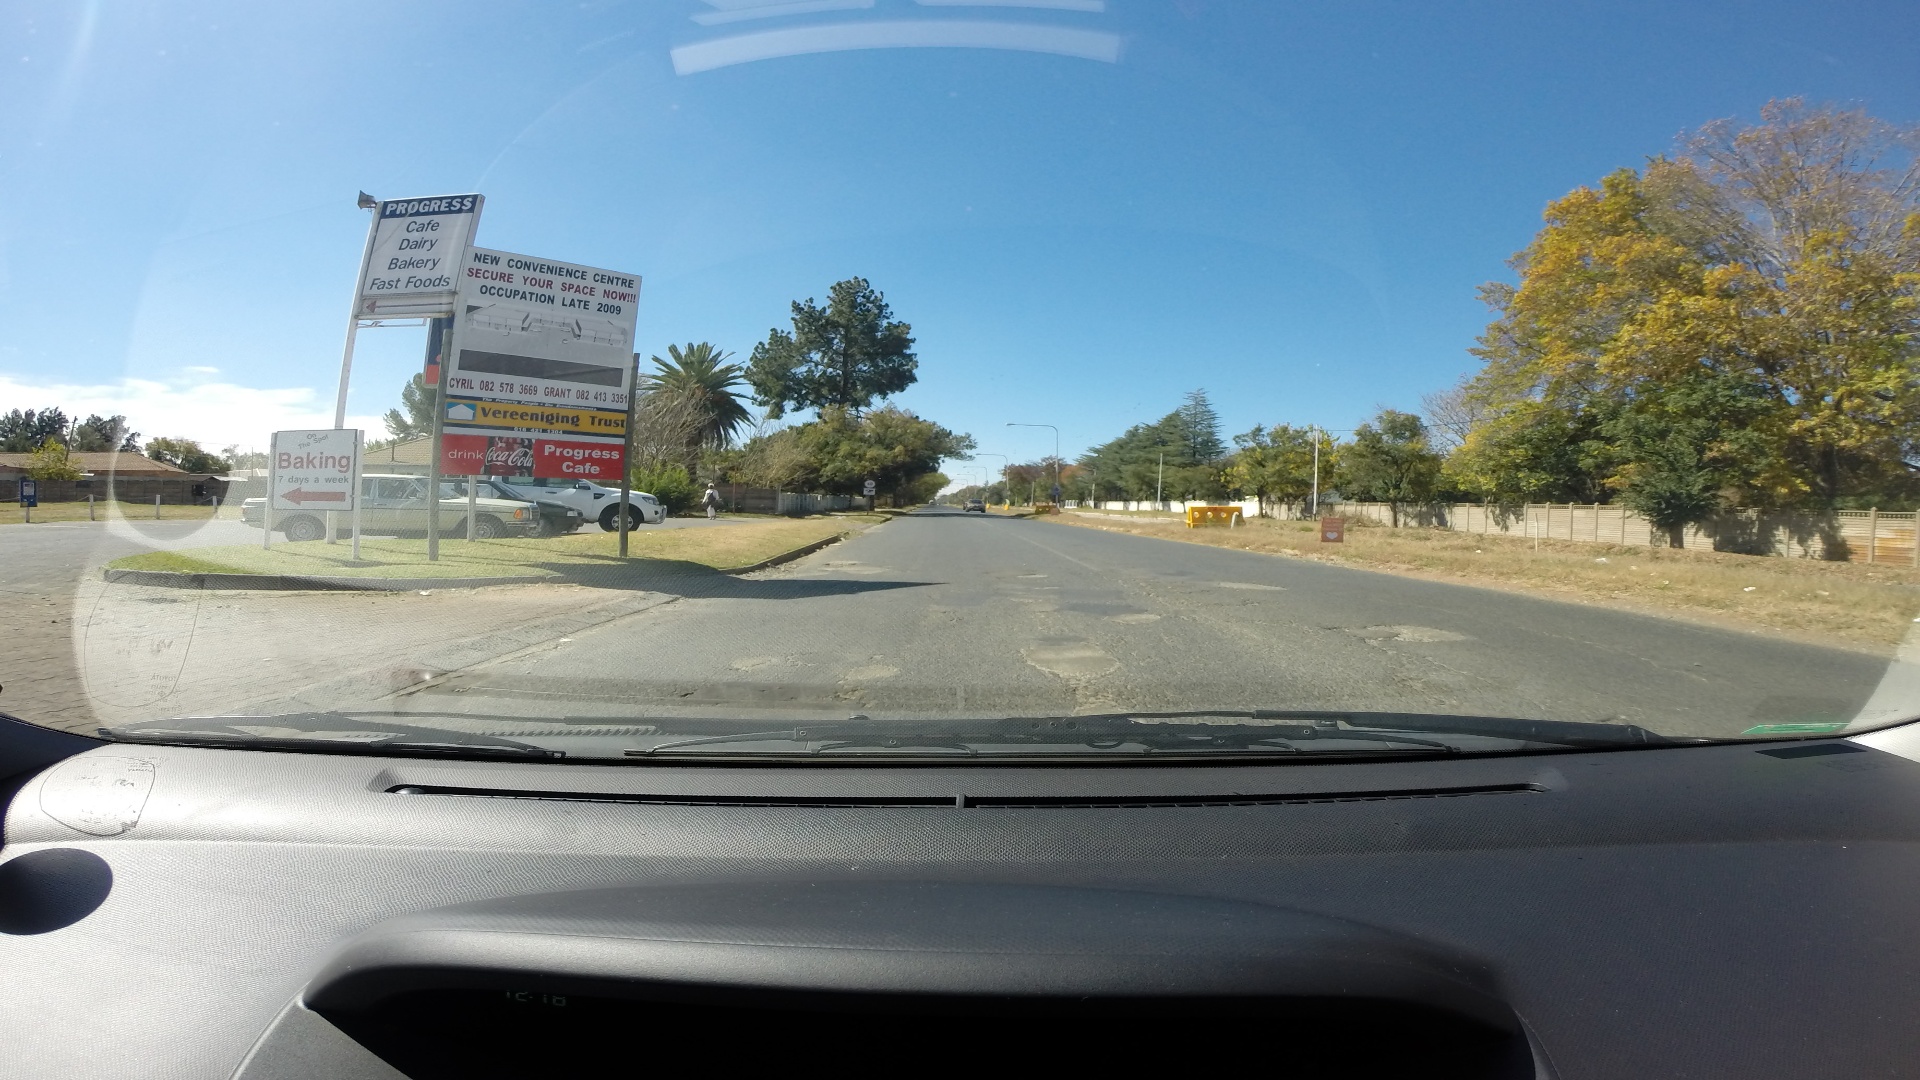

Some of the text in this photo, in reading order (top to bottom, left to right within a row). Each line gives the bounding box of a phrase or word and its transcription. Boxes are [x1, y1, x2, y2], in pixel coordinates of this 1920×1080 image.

[386, 197, 472, 215] PROGRESS
[406, 220, 439, 233] Cafe
[398, 237, 438, 251] Dairy
[388, 257, 441, 271] Bakery
[473, 252, 634, 288] NEW CONVENIENCE CENTRE
[369, 275, 450, 290] Fast Foods
[467, 267, 636, 303] SECURE YOUR SPACE NOW!!!
[480, 285, 621, 315] OCCUPATION LATE 2009
[450, 377, 628, 404] CYRIL 082 578 3669 GRANT 082 413 3351
[481, 407, 580, 427] Vereeniging
[589, 415, 625, 428] Trust
[448, 450, 484, 460] drink
[545, 444, 620, 460] Progress
[278, 452, 351, 473] Baking
[562, 461, 600, 474] Cafe
[278, 475, 284, 484] 7
[288, 475, 309, 486] days
[325, 475, 349, 484] week
